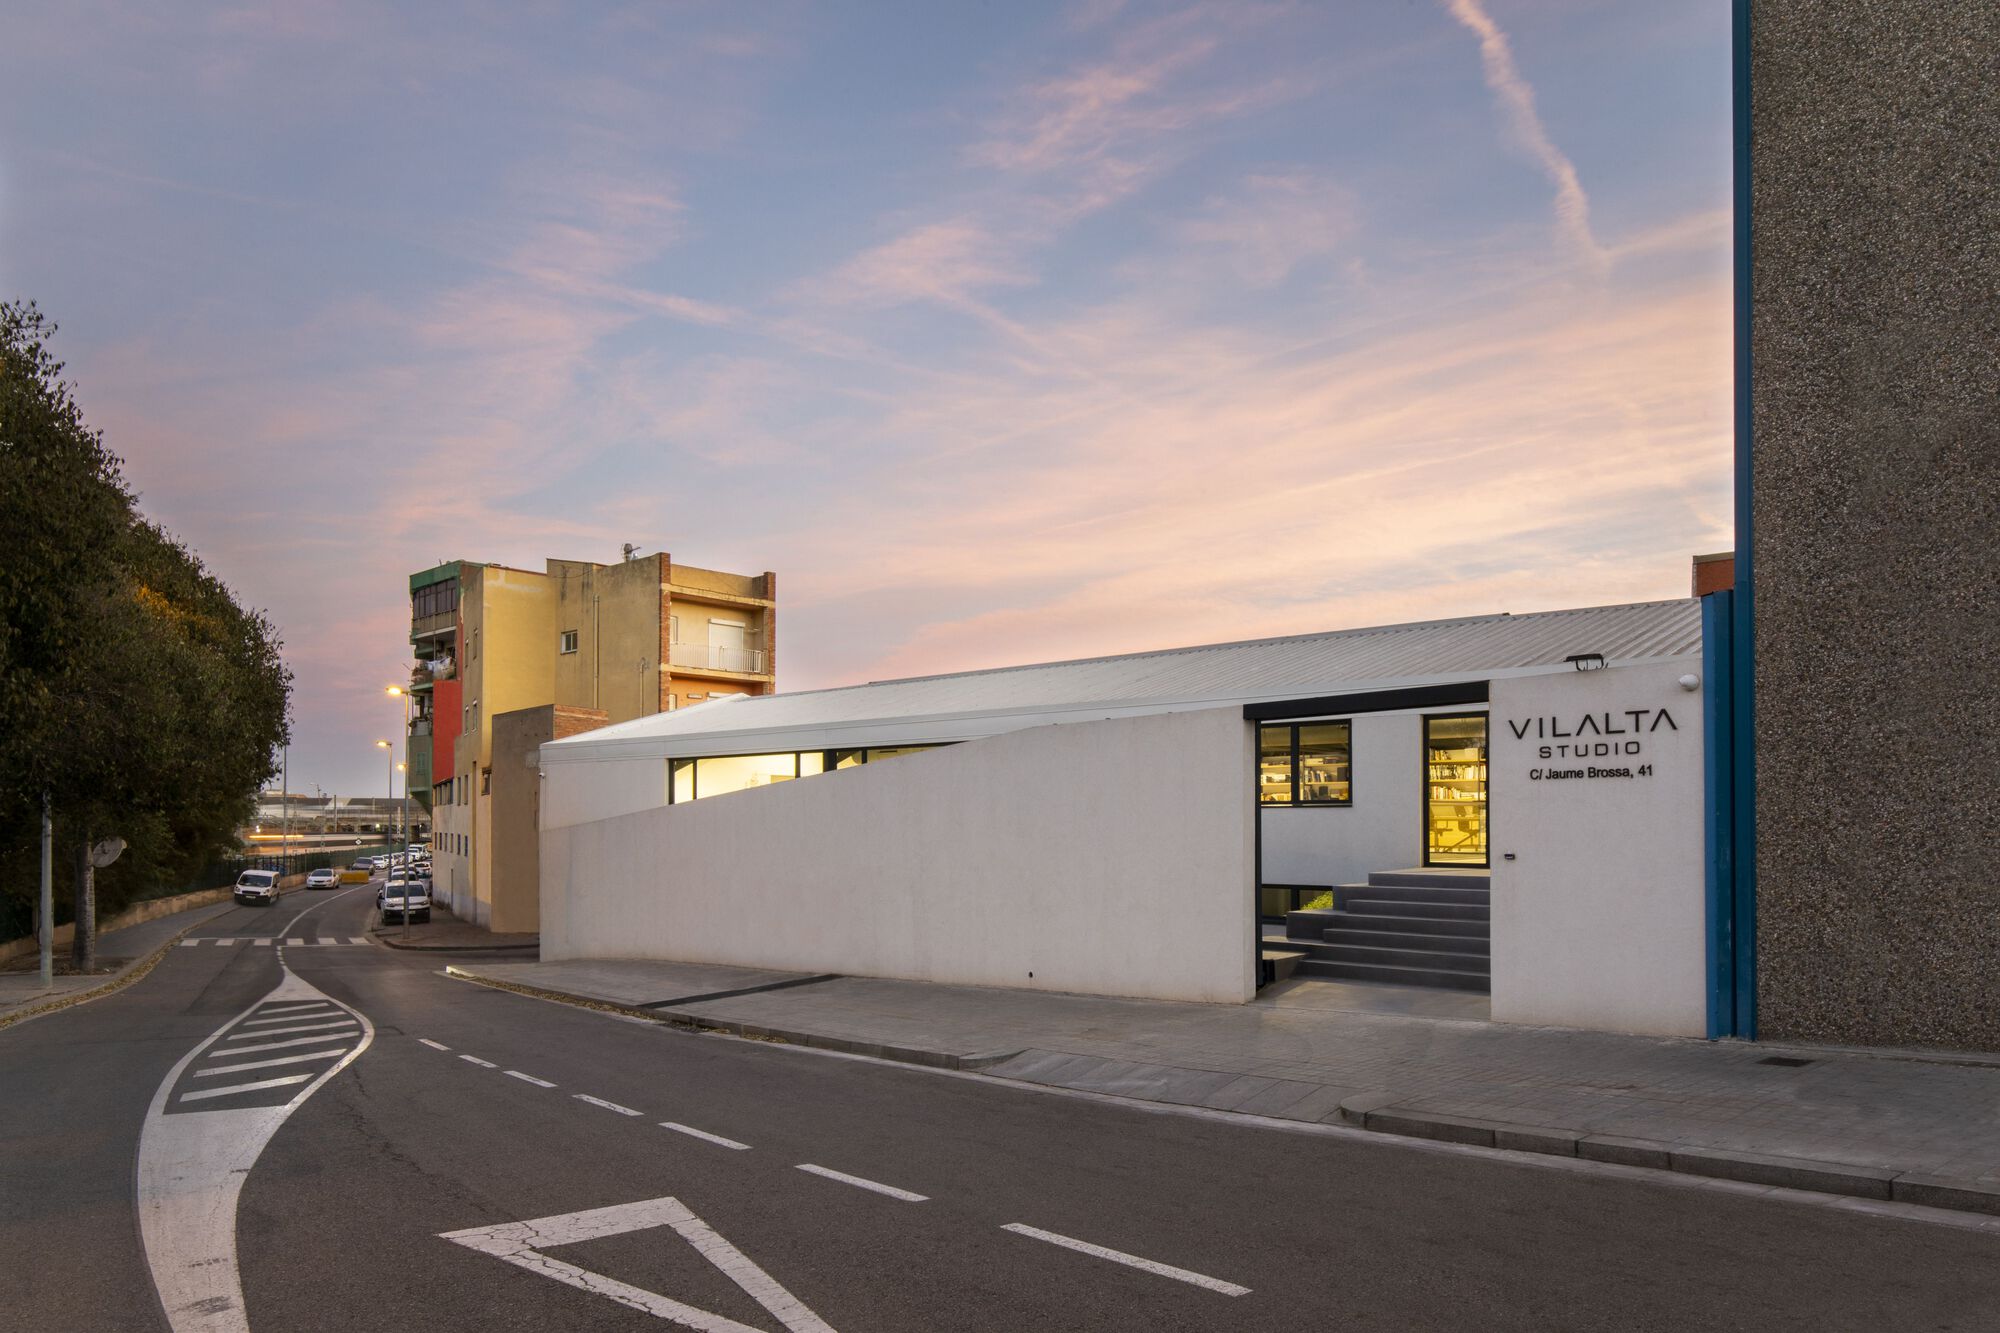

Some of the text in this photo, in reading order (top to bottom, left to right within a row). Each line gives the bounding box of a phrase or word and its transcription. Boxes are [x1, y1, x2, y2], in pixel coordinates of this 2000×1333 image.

[1508, 708, 1678, 740] VILALTA
[1539, 741, 1641, 759] STUDIO
[1529, 764, 1653, 780] C/ Jaume Brossa, 41
